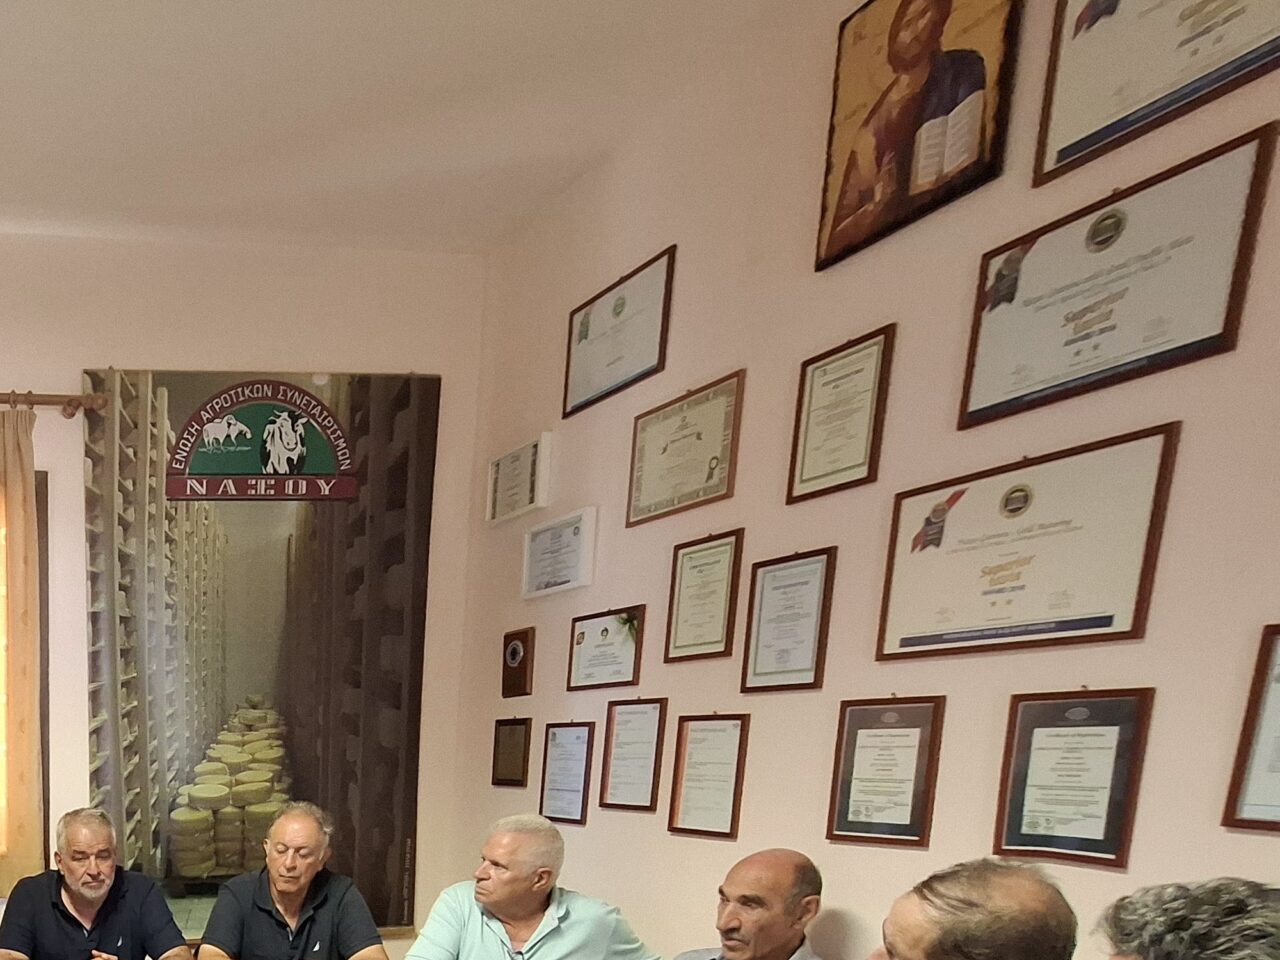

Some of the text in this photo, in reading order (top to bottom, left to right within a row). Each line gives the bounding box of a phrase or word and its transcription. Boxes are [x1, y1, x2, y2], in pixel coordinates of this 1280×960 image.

[172, 384, 352, 470] ΕΝΩΣΗ ΑΓΡΟΤΙΚΩΝ ΣΥΝΕΤΑΙΡΙΣΜΩΝ
[186, 478, 337, 496] ΝΑΞΟΥ
